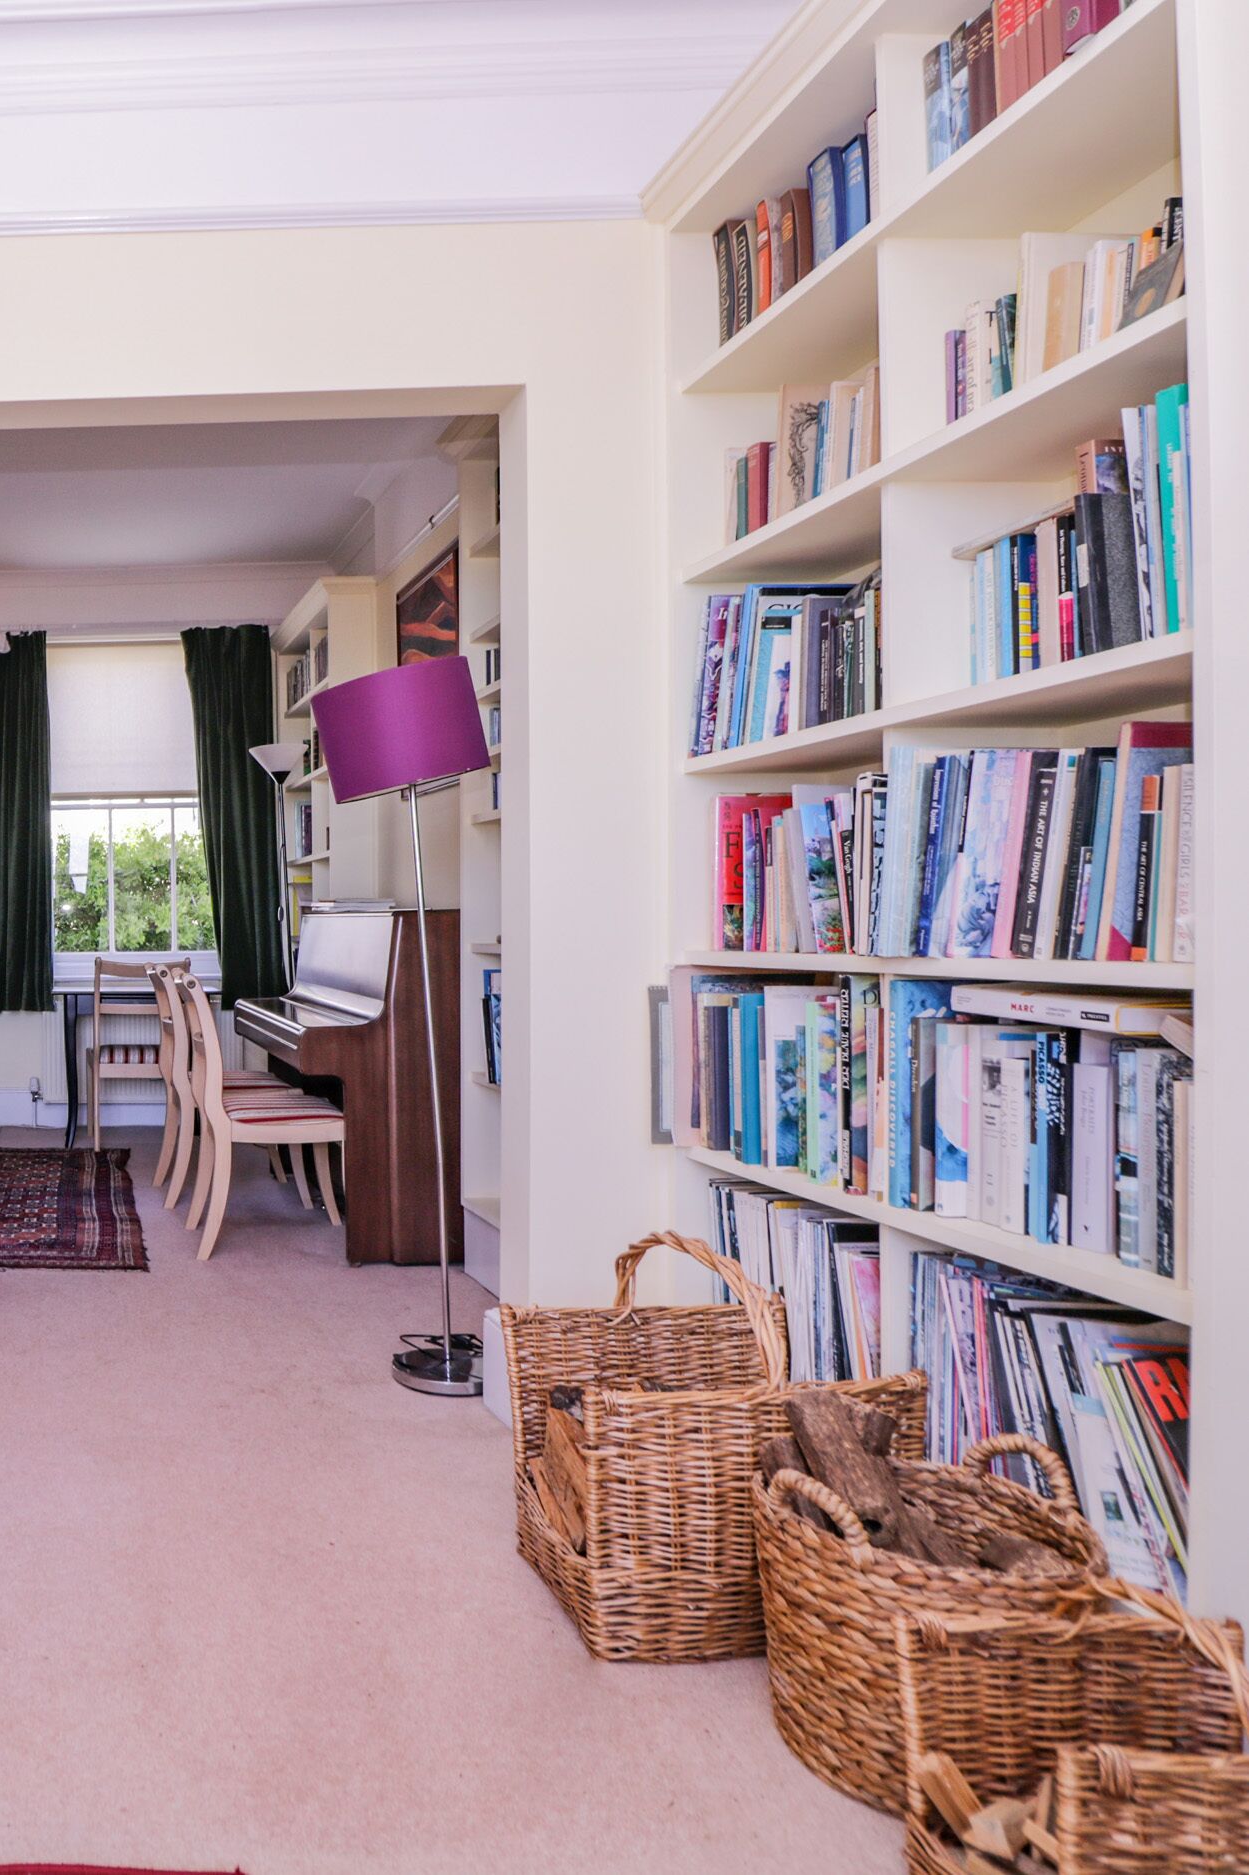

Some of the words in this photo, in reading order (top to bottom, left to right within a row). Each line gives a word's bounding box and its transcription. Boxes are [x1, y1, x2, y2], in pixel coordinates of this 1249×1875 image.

[967, 377, 977, 389] of
[1039, 800, 1049, 816] THE
[1181, 777, 1193, 828] SILENCE
[1036, 818, 1046, 836] ART
[723, 831, 740, 858] F
[843, 839, 852, 854] Van
[1034, 836, 1043, 849] OF
[843, 854, 852, 874] Gogh
[1030, 851, 1041, 882] INDIAN
[1179, 843, 1191, 879] GIRLS
[1026, 883, 1038, 904] ASIA
[1137, 877, 1145, 905] CENTRAL
[840, 988, 850, 1027] REITER
[1010, 1002, 1035, 1014] MARC
[840, 1031, 850, 1062] BLAUE
[888, 1011, 896, 1074] CHAGALL
[841, 1066, 850, 1089] DER
[910, 1059, 919, 1093] Dresden
[888, 1080, 897, 1168] DISCOVERED
[1000, 1084, 1008, 1148] PICASSO
[1011, 1101, 1019, 1126] LIFE
